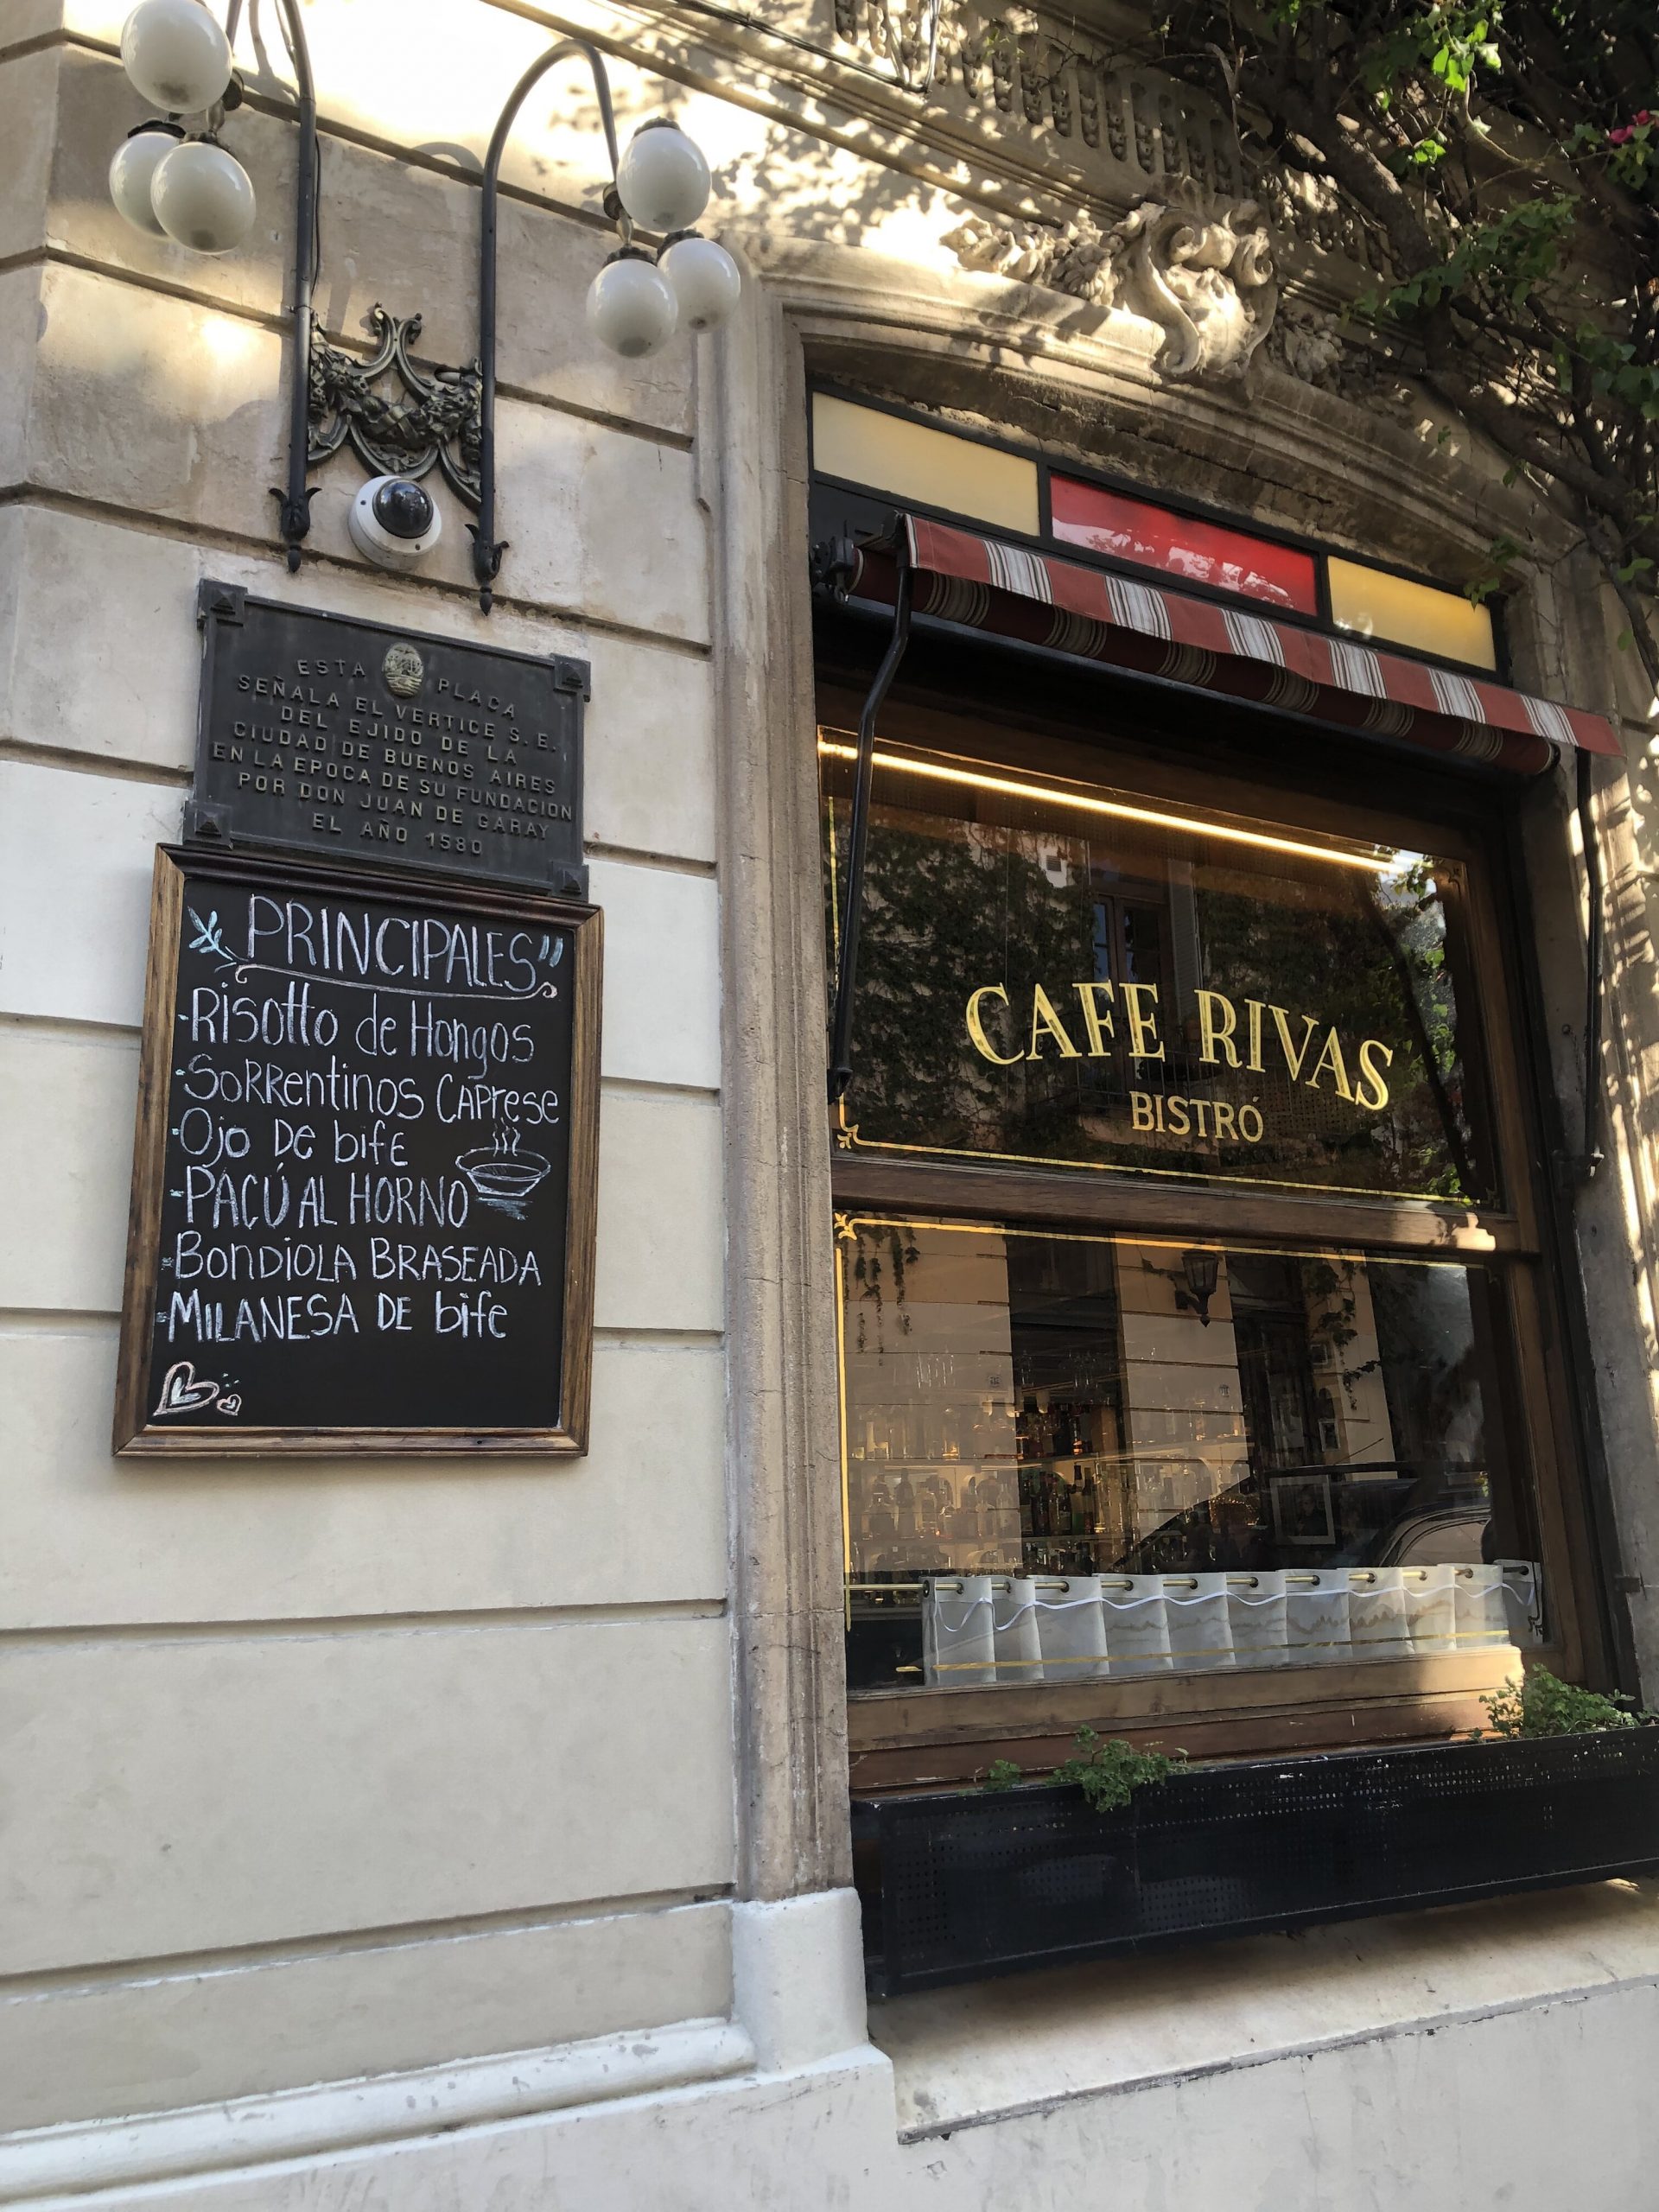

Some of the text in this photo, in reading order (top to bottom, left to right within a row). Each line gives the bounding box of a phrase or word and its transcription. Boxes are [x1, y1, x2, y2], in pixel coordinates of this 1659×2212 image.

[238, 675, 340, 709] SEÑALA
[356, 696, 383, 717] EL
[397, 704, 495, 739] VERTICE
[297, 659, 516, 720] ESTA PLACA
[234, 721, 555, 795] CIUDAD DE BUENOS AIRES
[281, 705, 517, 765] DEL EJIDO DE LA
[213, 741, 573, 821] EN LA EPOCA DE SU FUNDACION
[237, 772, 550, 840] POR DON JUAN DE GARAY
[312, 812, 482, 855] EL AÑO 1580
[192, 982, 535, 1079] Risotto de Hongos
[965, 979, 1394, 1111] CAFE RIVAS
[180, 1107, 251, 1168] Ojo
[1129, 1090, 1264, 1143] BISTRÓ
[298, 1174, 338, 1229] AL
[349, 1173, 468, 1229] HORNO
[370, 1236, 542, 1287] BRASEADA
[168, 1288, 509, 1343] MILANESA DE bife
